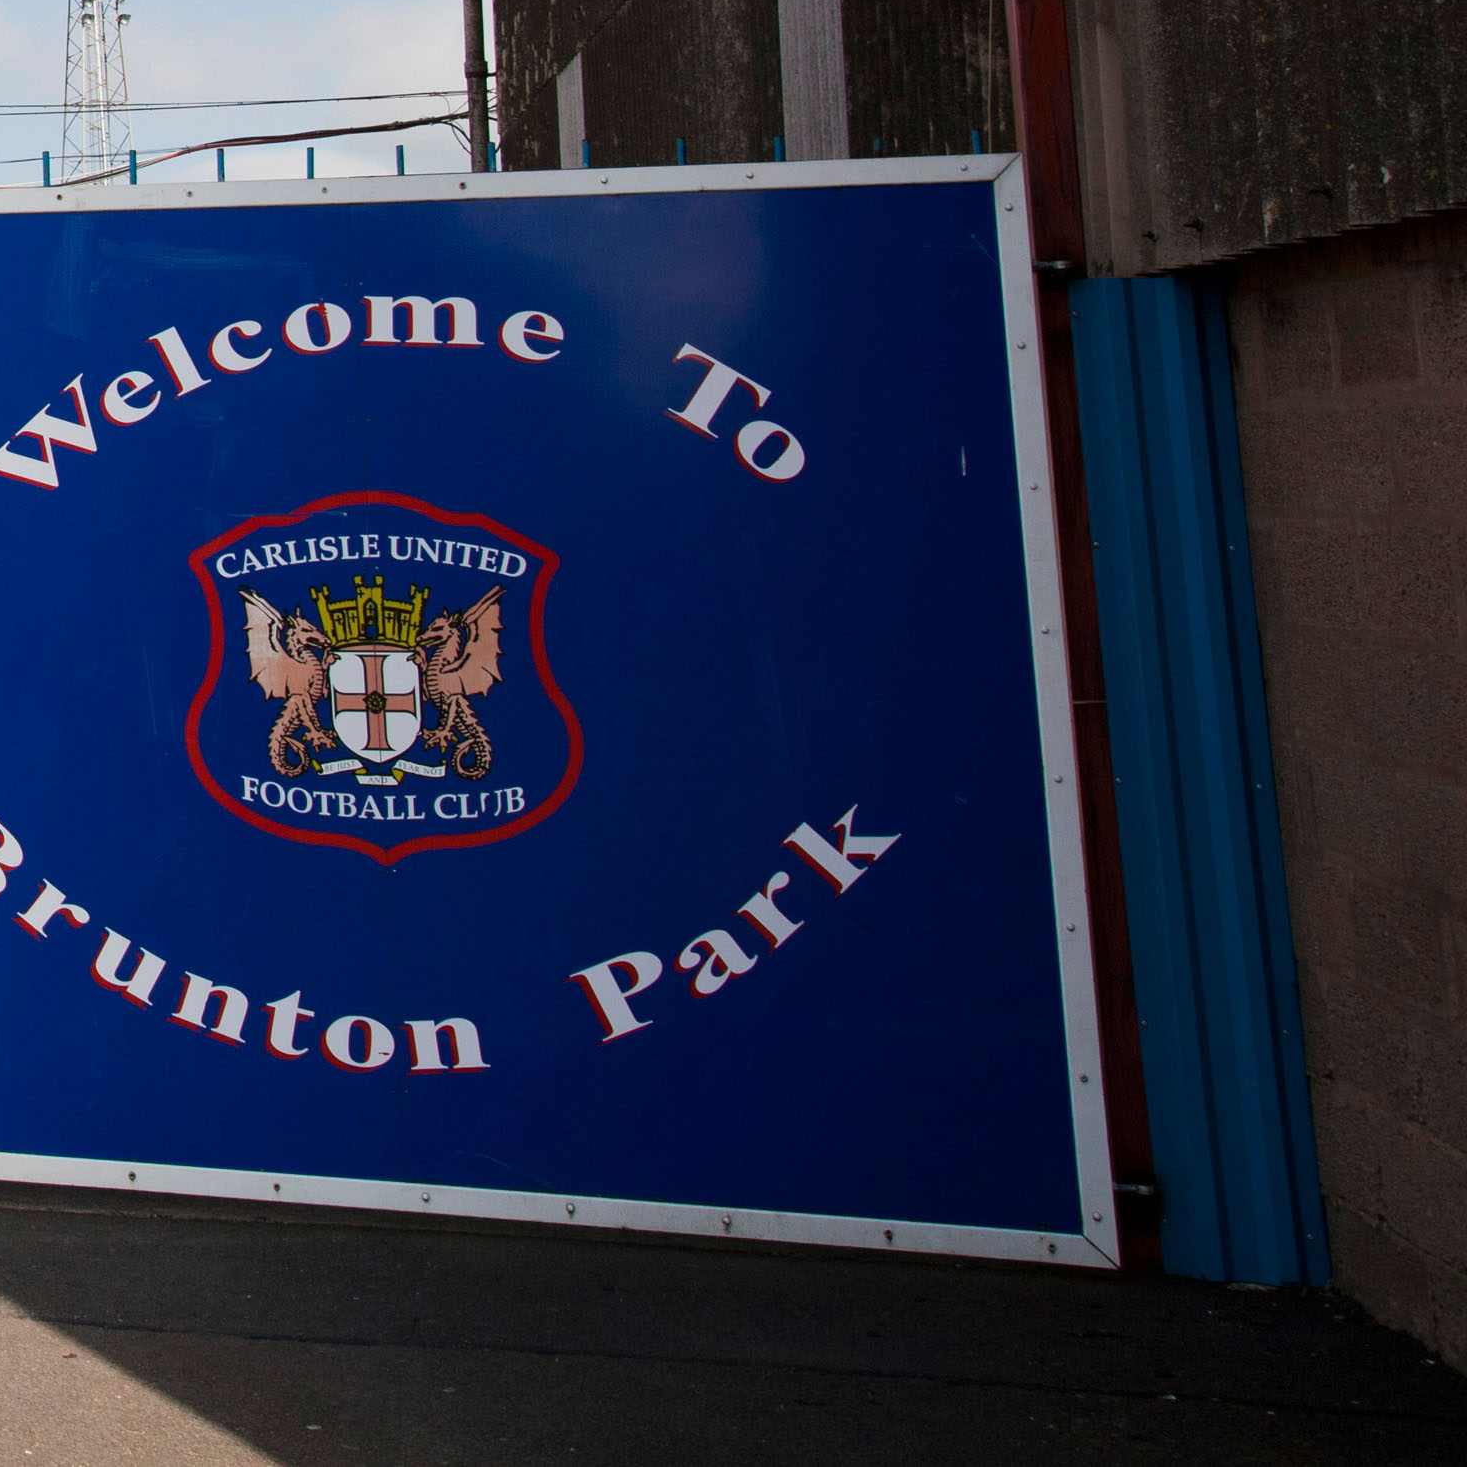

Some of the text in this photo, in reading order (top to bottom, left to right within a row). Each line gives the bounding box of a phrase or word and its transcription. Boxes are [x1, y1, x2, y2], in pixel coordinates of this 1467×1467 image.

[667, 341, 806, 484] To
[216, 535, 527, 578] CARLISLE UNITED
[337, 761, 355, 771] JUST
[398, 762, 443, 776] FEAR NOT
[241, 775, 425, 821] FOOTBALL
[568, 803, 902, 1045] Park
